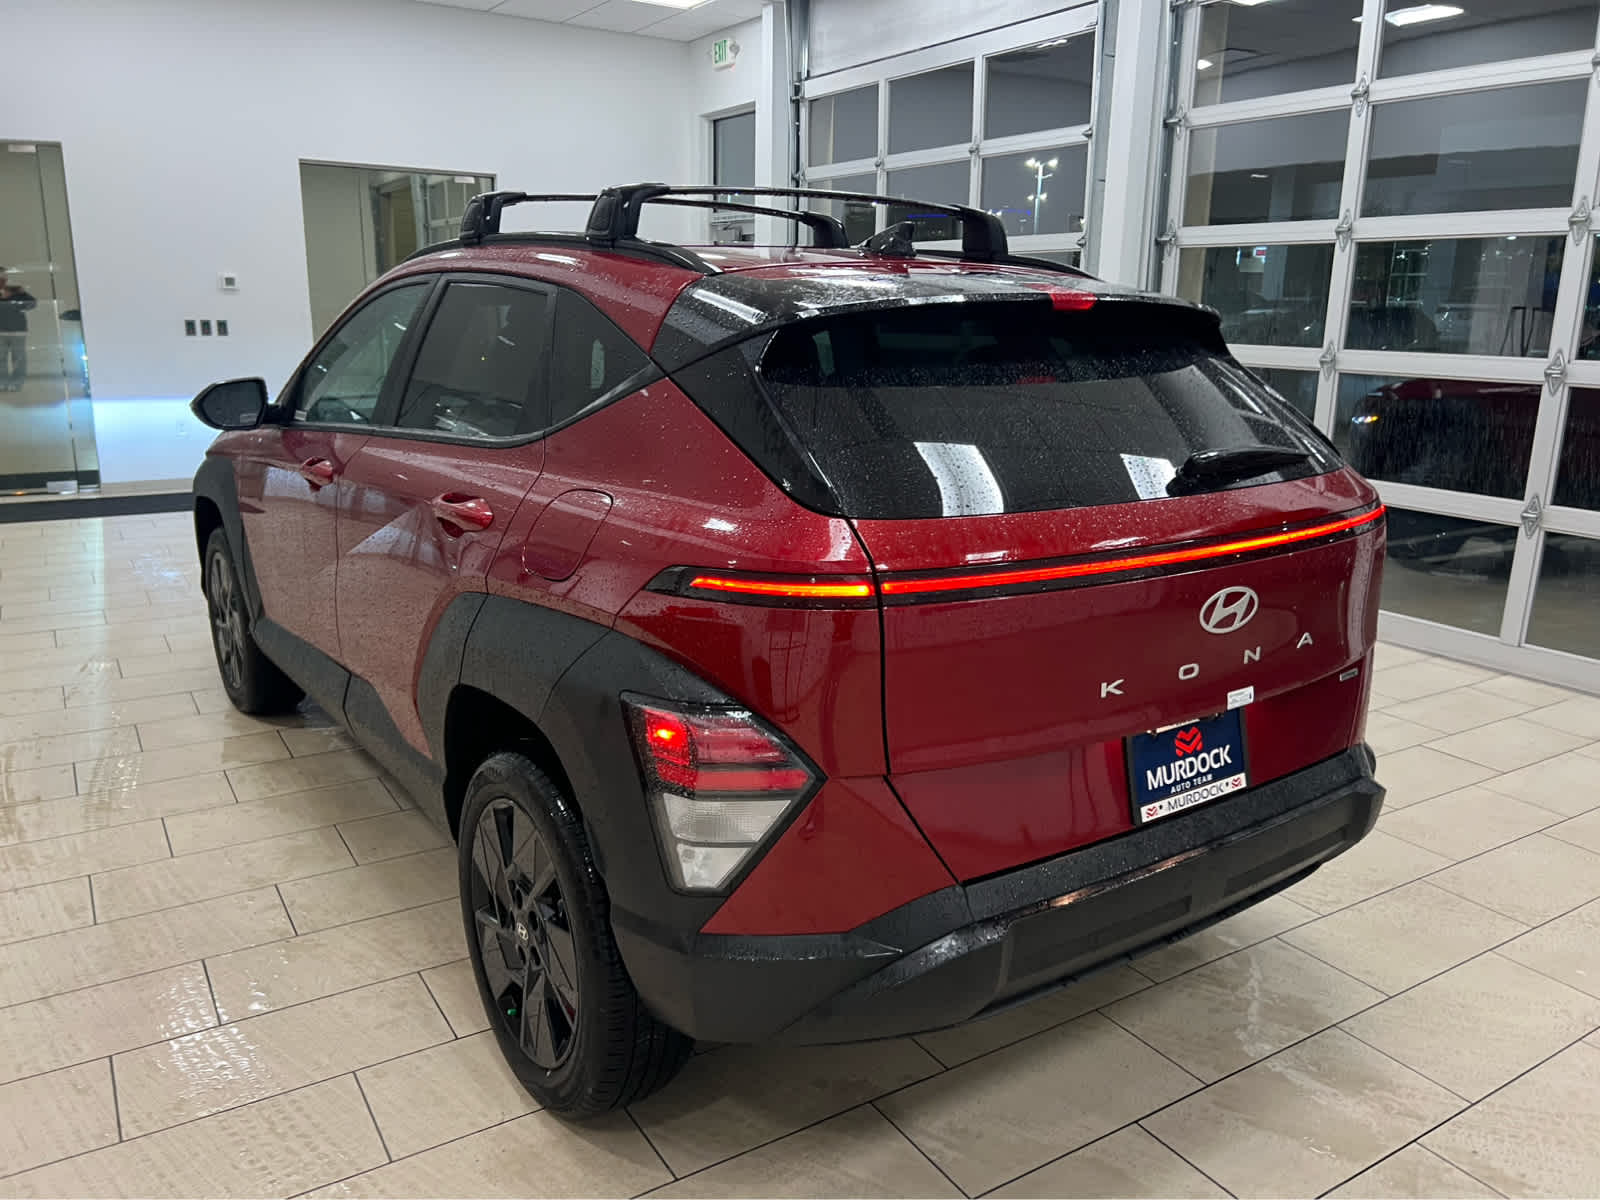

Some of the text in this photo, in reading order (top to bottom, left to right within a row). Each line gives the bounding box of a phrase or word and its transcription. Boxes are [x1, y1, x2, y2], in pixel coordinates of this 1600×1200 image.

[714, 40, 728, 64] EXIT
[1146, 744, 1232, 791] MURDOCK
[1167, 782, 1224, 812] MURDOCK
[1170, 773, 1213, 794] AUTO TEAM
